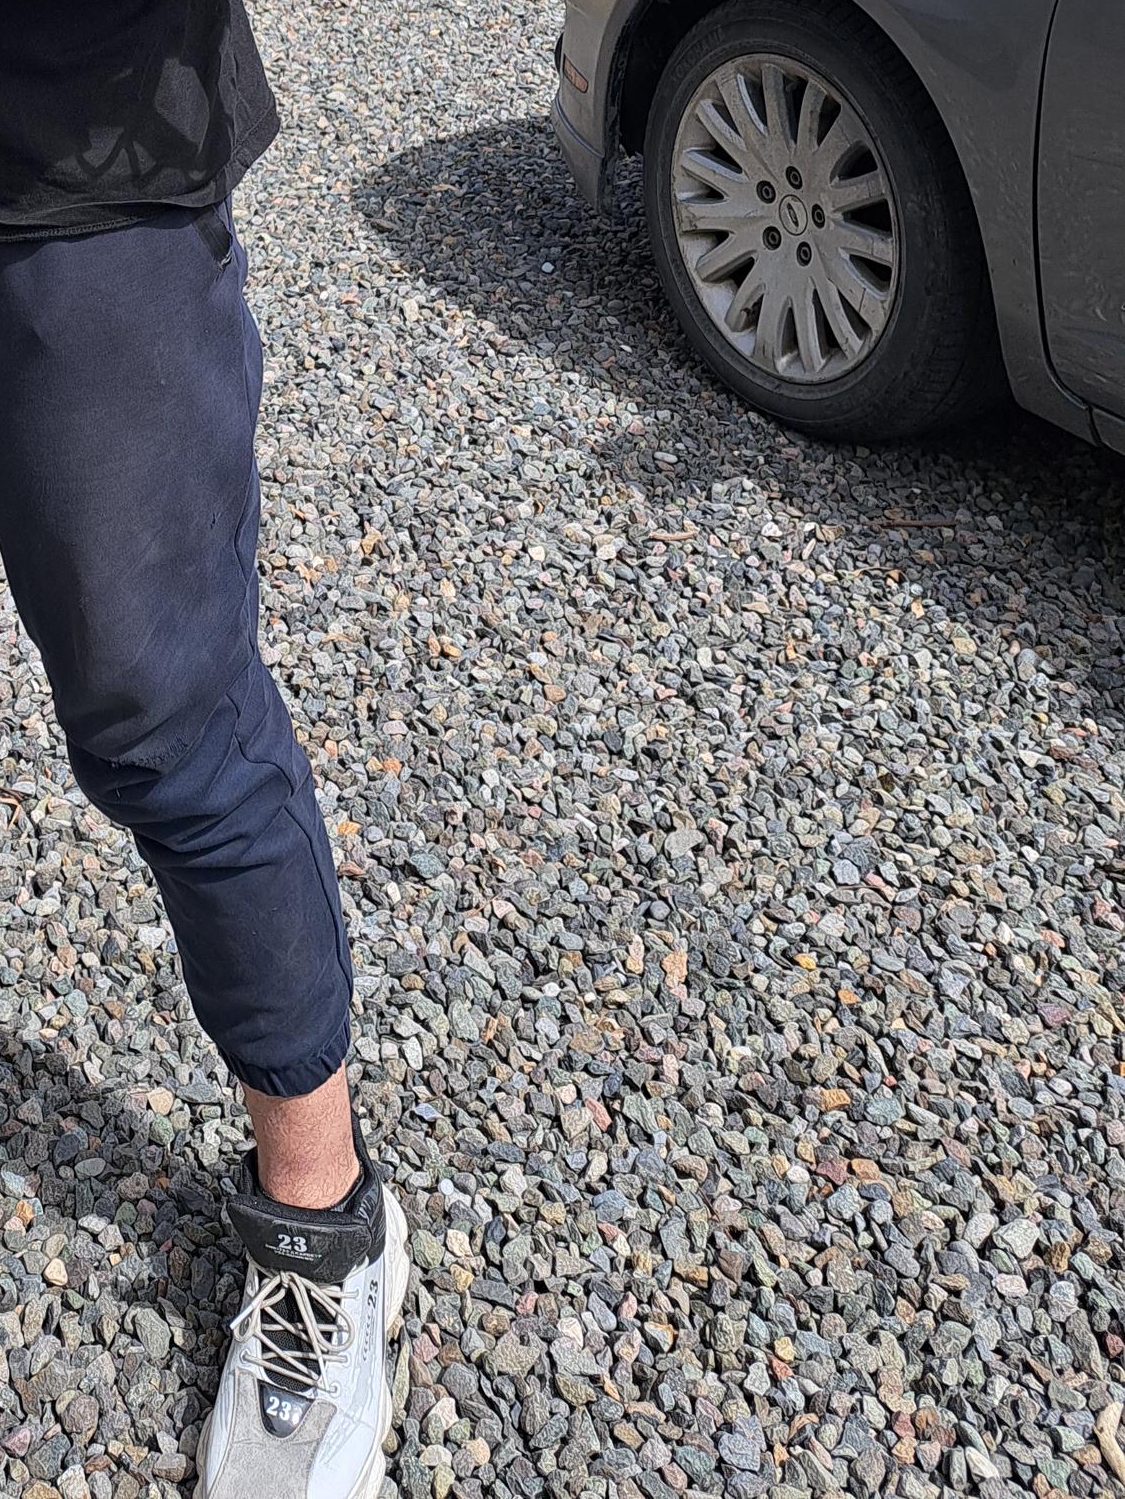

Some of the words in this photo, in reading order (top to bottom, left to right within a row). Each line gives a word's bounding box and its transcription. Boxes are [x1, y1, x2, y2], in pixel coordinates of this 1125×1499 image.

[277, 1234, 308, 1252] 23
[367, 1279, 379, 1308] 23
[266, 1396, 292, 1421] 23
